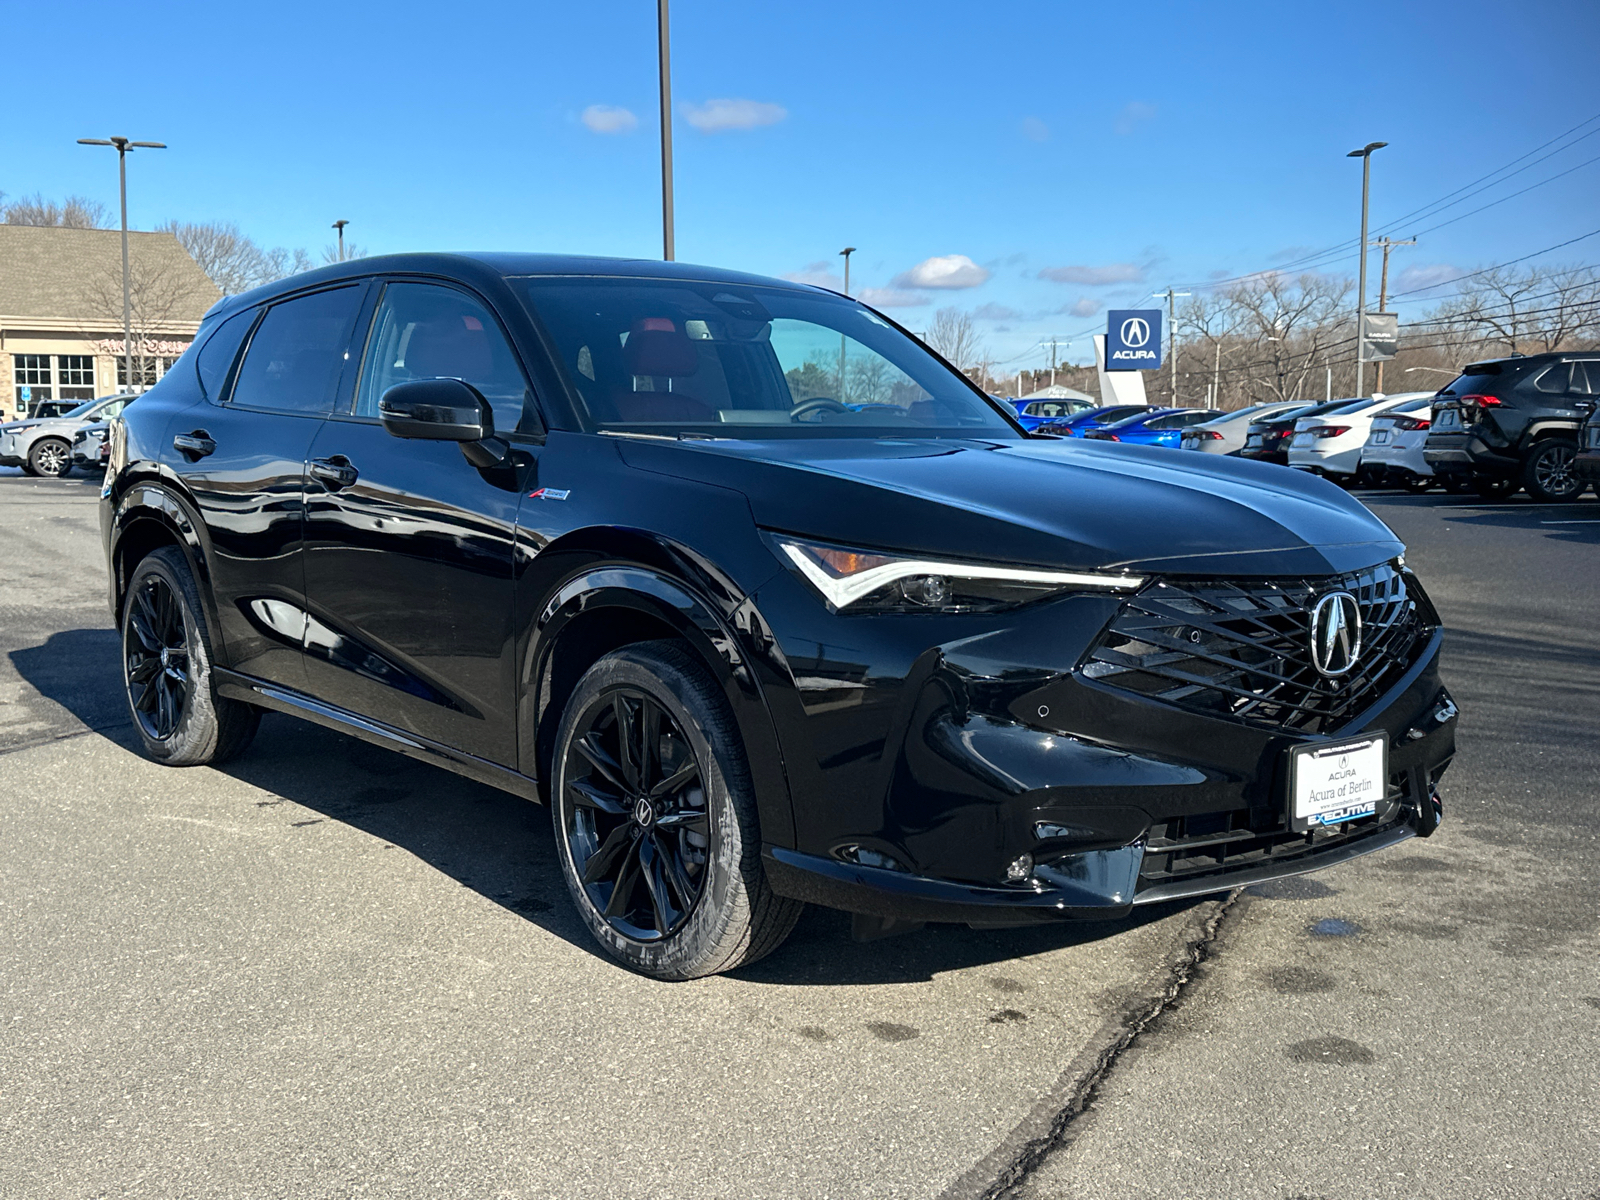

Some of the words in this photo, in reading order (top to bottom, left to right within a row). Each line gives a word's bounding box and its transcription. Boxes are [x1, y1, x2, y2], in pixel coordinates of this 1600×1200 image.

[1112, 350, 1157, 359] ACURA
[1328, 768, 1357, 781] ACURA
[1308, 789, 1335, 803] Acura
[1337, 784, 1347, 797] of
[1349, 778, 1372, 795] Berlin
[1307, 802, 1376, 826] EXECUTIVE
